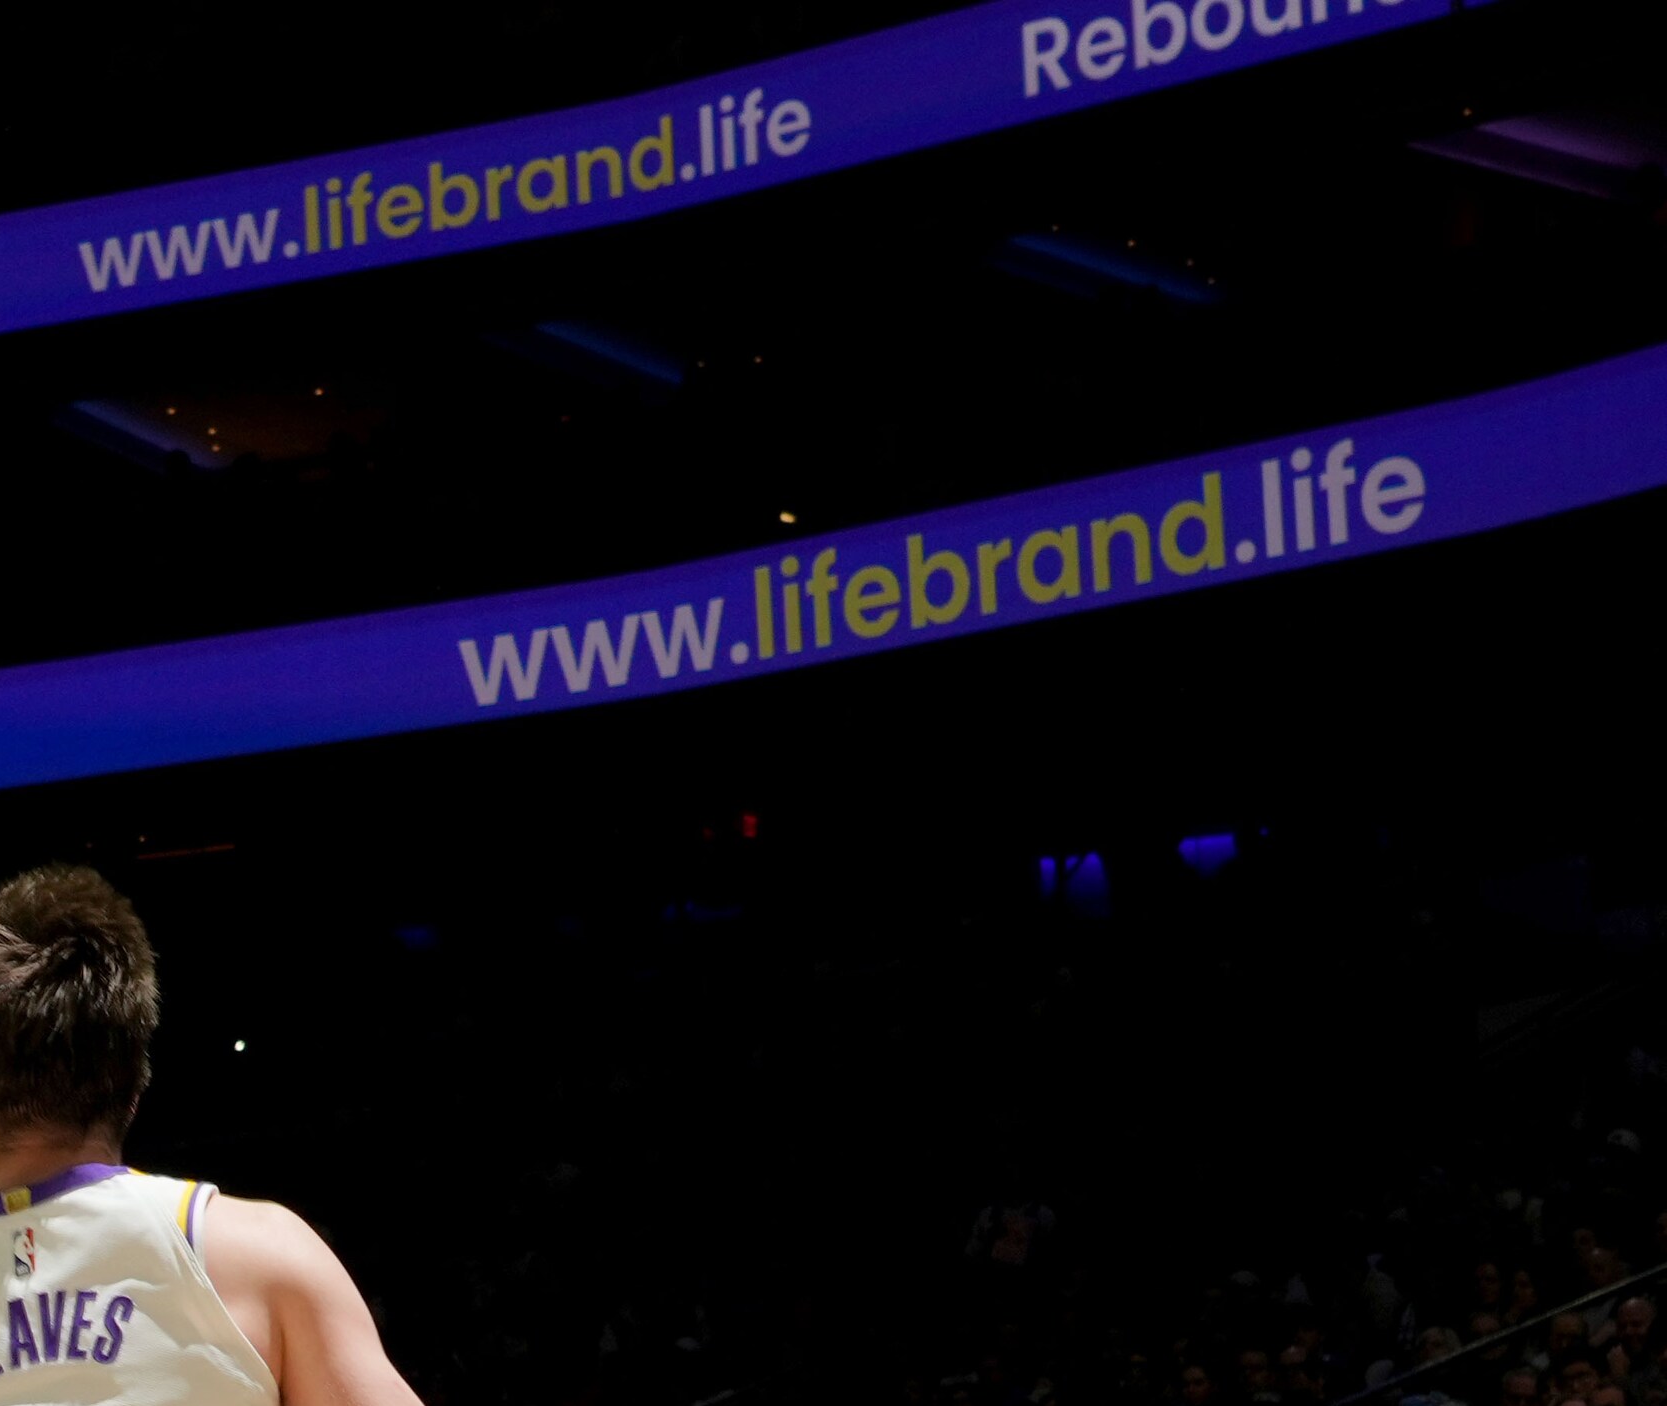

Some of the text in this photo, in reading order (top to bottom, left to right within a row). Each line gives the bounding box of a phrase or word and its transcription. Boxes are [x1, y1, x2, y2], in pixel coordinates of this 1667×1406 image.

[1022, 0, 1407, 97] Rebou
[79, 88, 811, 292] www.lifebrand.life
[458, 438, 1426, 707] www.lifebrand.life
